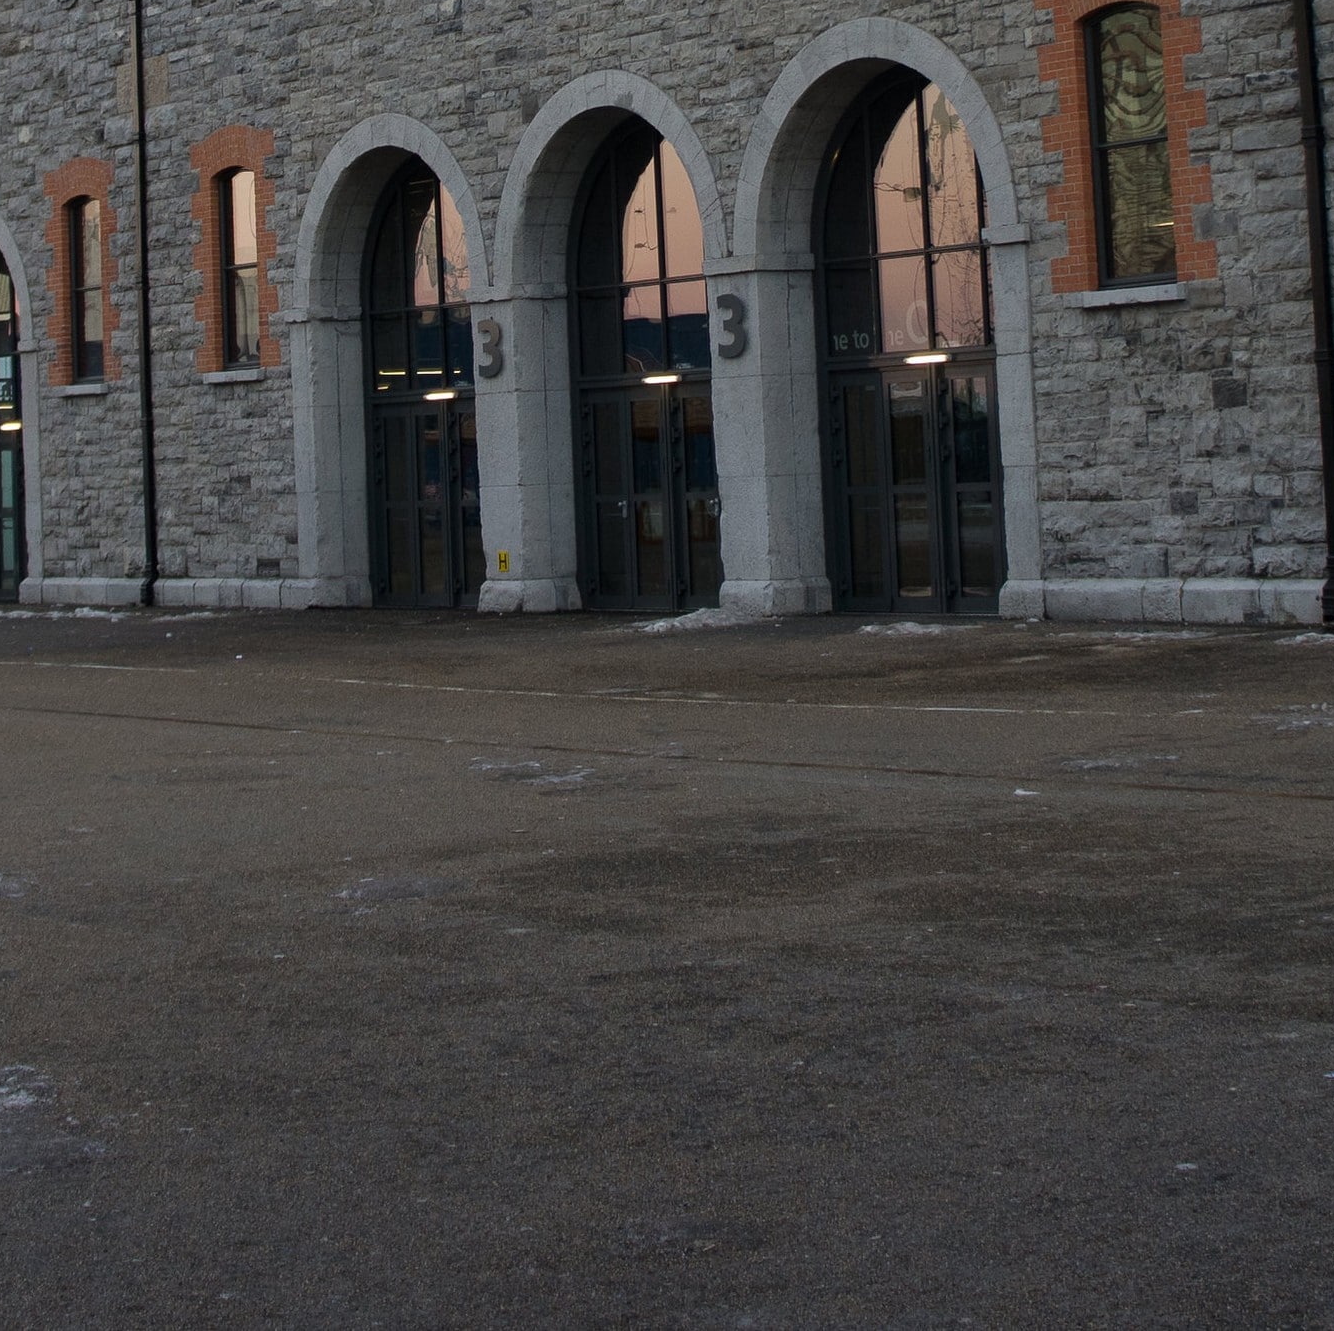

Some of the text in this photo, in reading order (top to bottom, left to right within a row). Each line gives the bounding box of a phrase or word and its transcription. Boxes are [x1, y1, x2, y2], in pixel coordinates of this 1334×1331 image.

[477, 319, 503, 378] 3
[717, 293, 747, 359] 3
[498, 553, 507, 570] H
